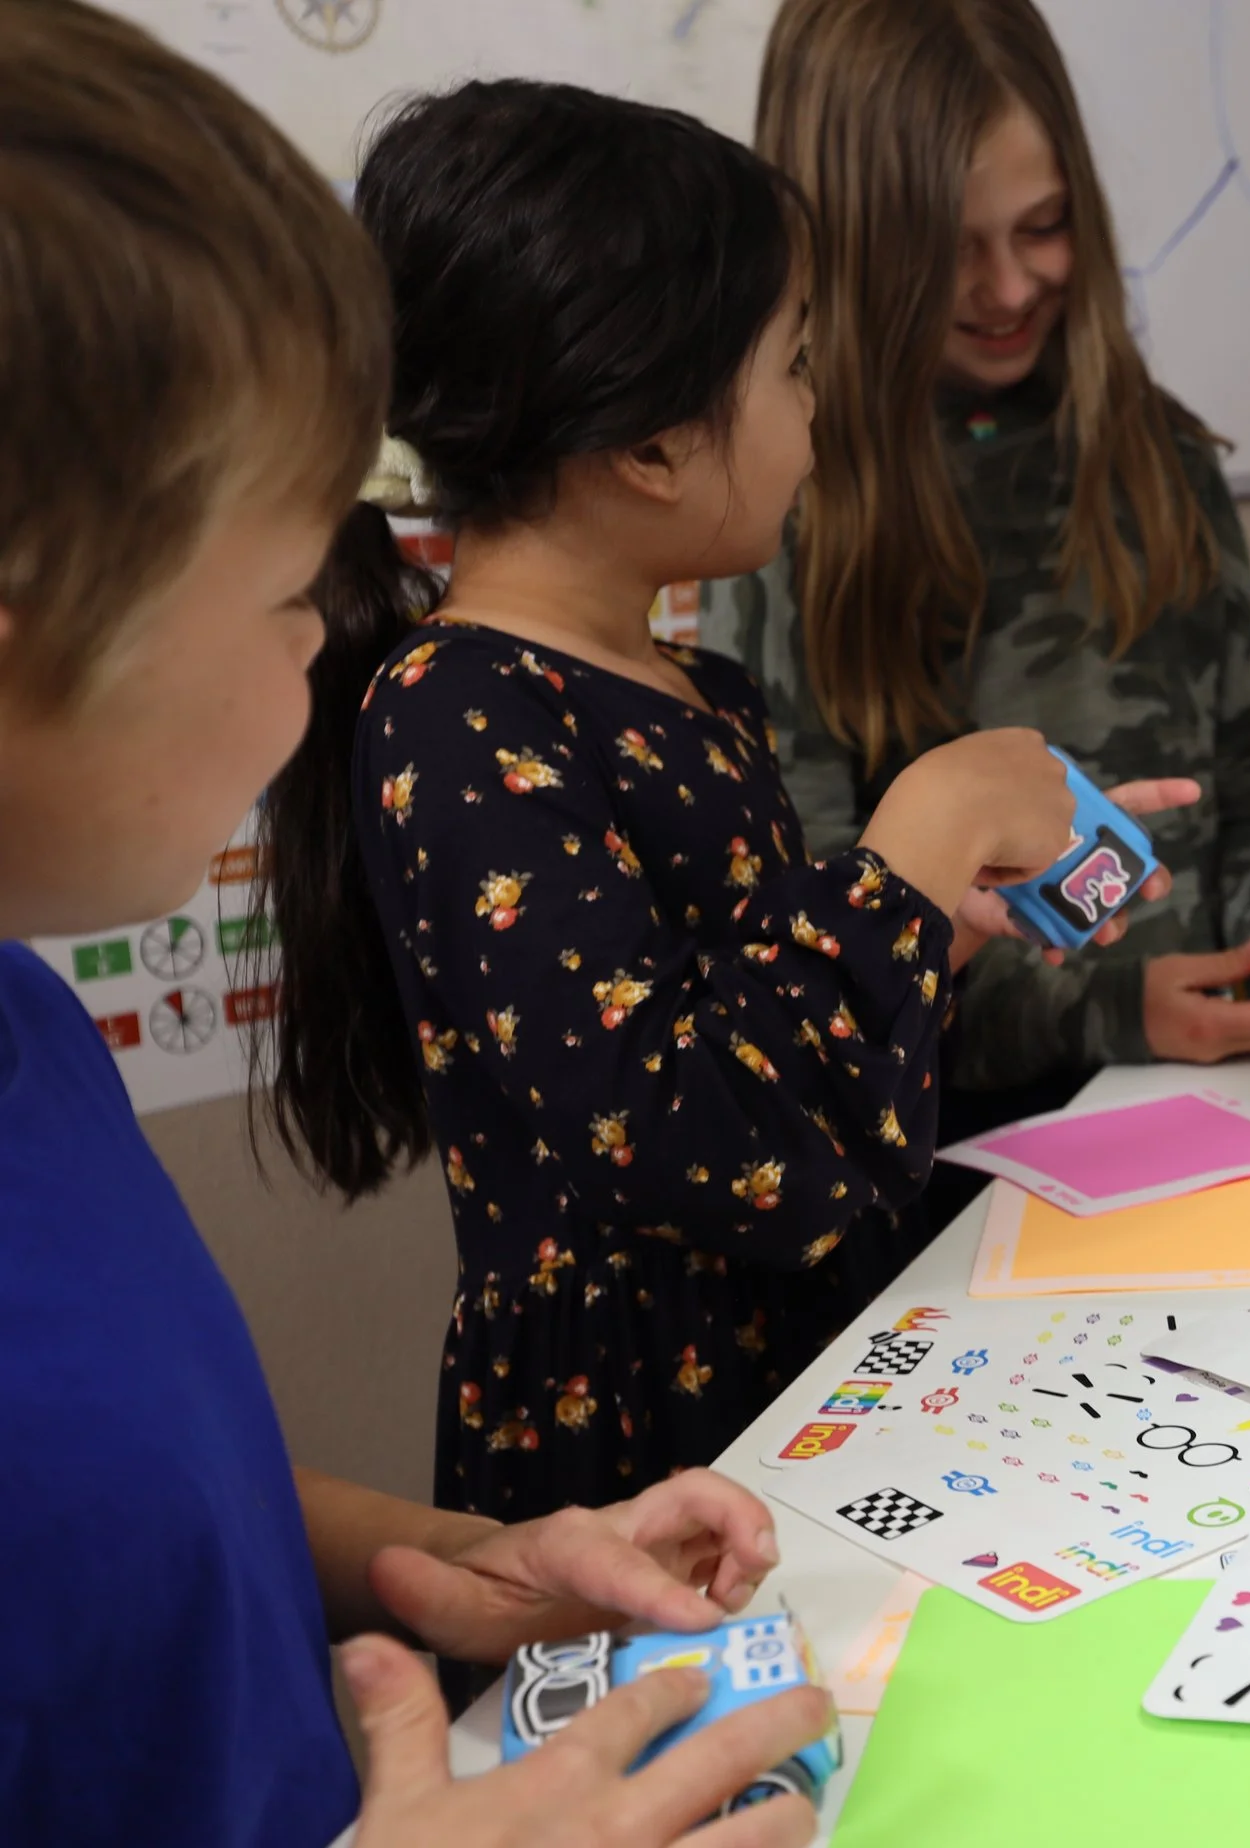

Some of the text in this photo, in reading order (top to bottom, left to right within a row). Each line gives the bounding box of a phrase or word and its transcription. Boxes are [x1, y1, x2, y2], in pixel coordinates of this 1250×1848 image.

[788, 1424, 848, 1457] indi
[1109, 1520, 1195, 1560] indi
[1053, 1540, 1141, 1582] indi
[988, 1565, 1071, 1609] indi
